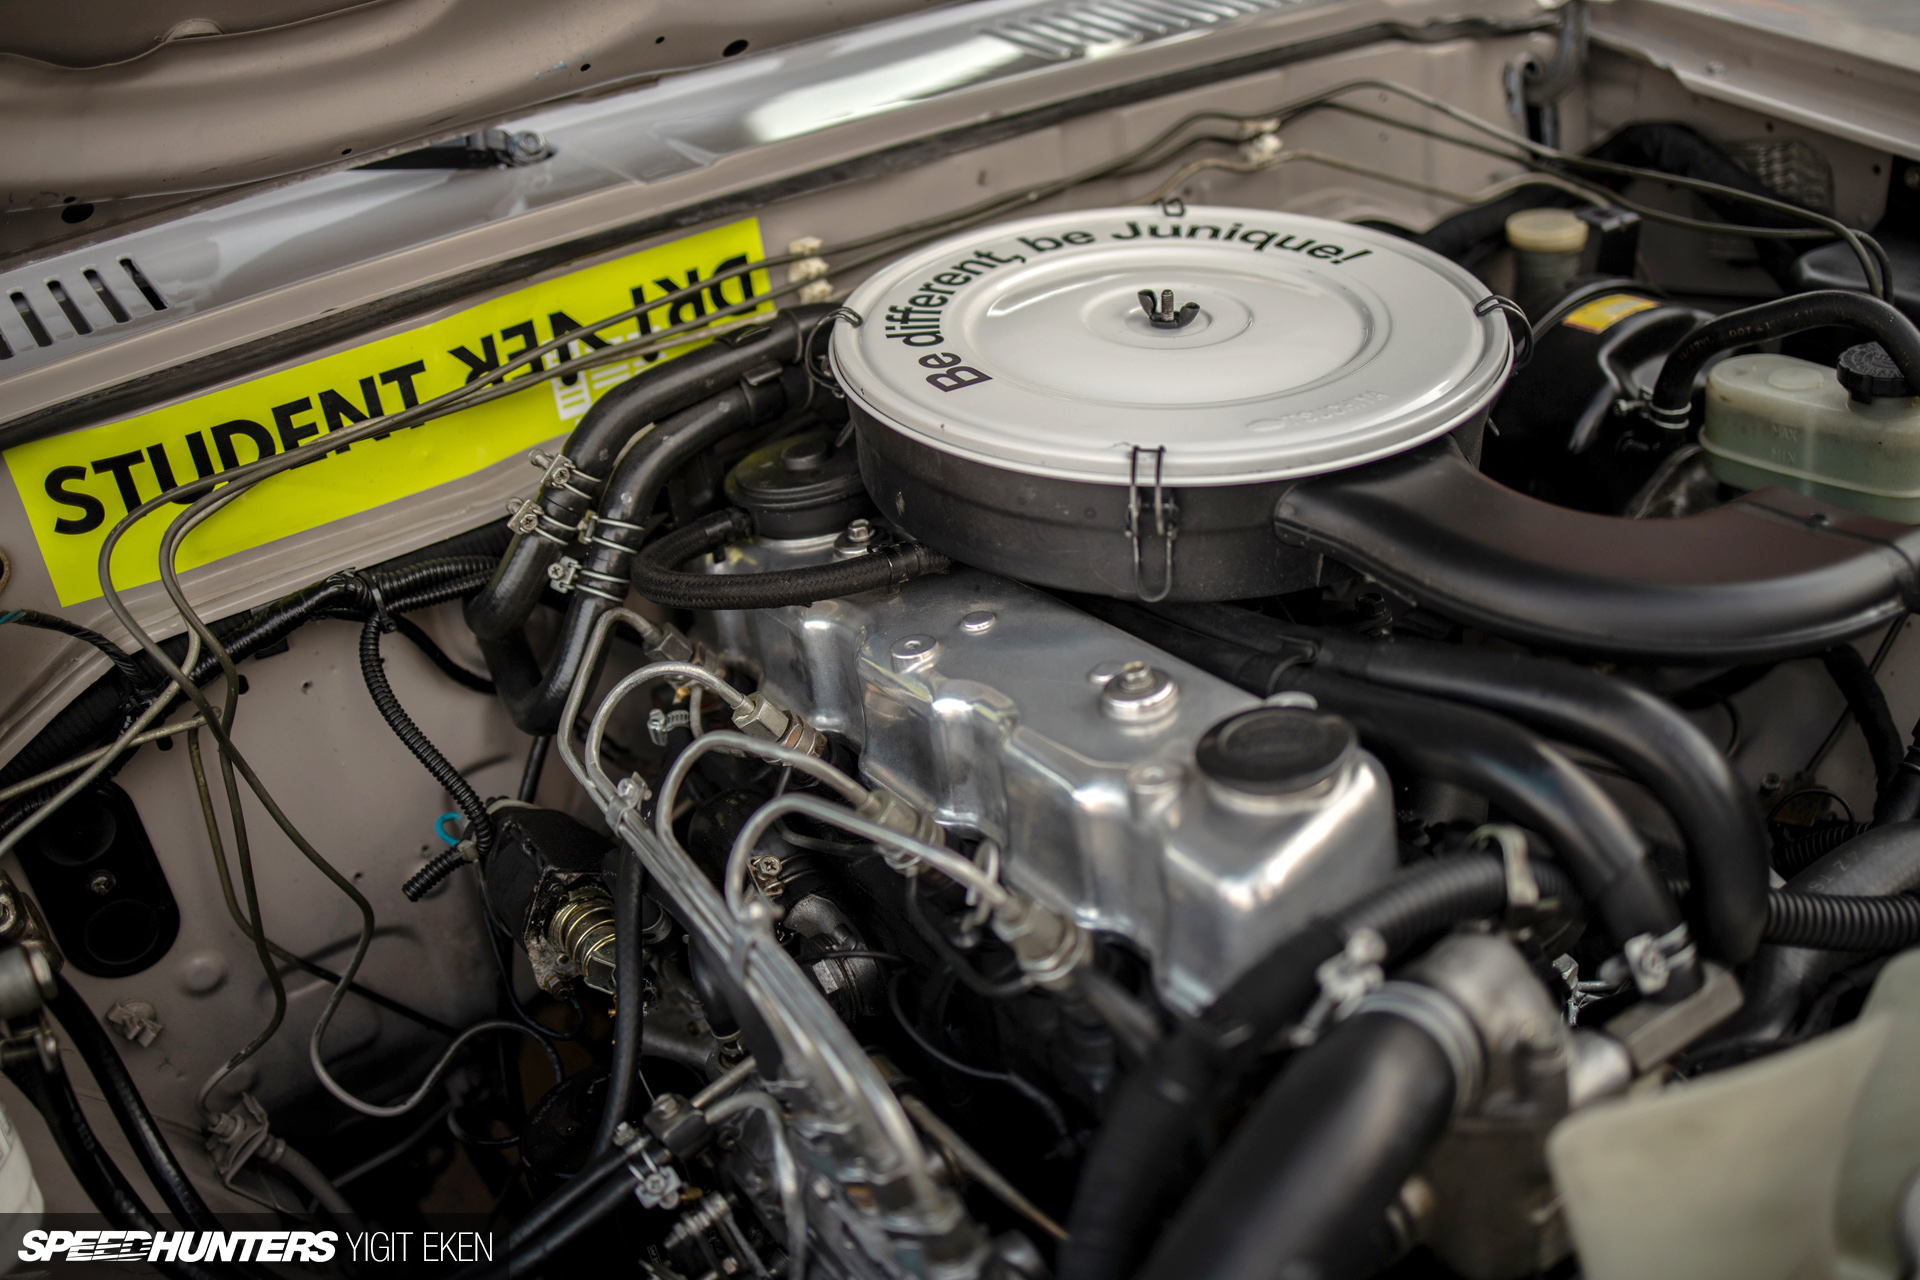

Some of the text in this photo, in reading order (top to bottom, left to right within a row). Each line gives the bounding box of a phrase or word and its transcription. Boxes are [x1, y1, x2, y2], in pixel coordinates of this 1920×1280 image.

[447, 253, 758, 387] DRIVER
[885, 221, 1373, 393] Be different, be Junique!
[1729, 326, 1750, 339] DOT
[43, 359, 428, 536] STUDENT
[1771, 447, 1796, 464] MIN
[1772, 423, 1798, 442] MAX
